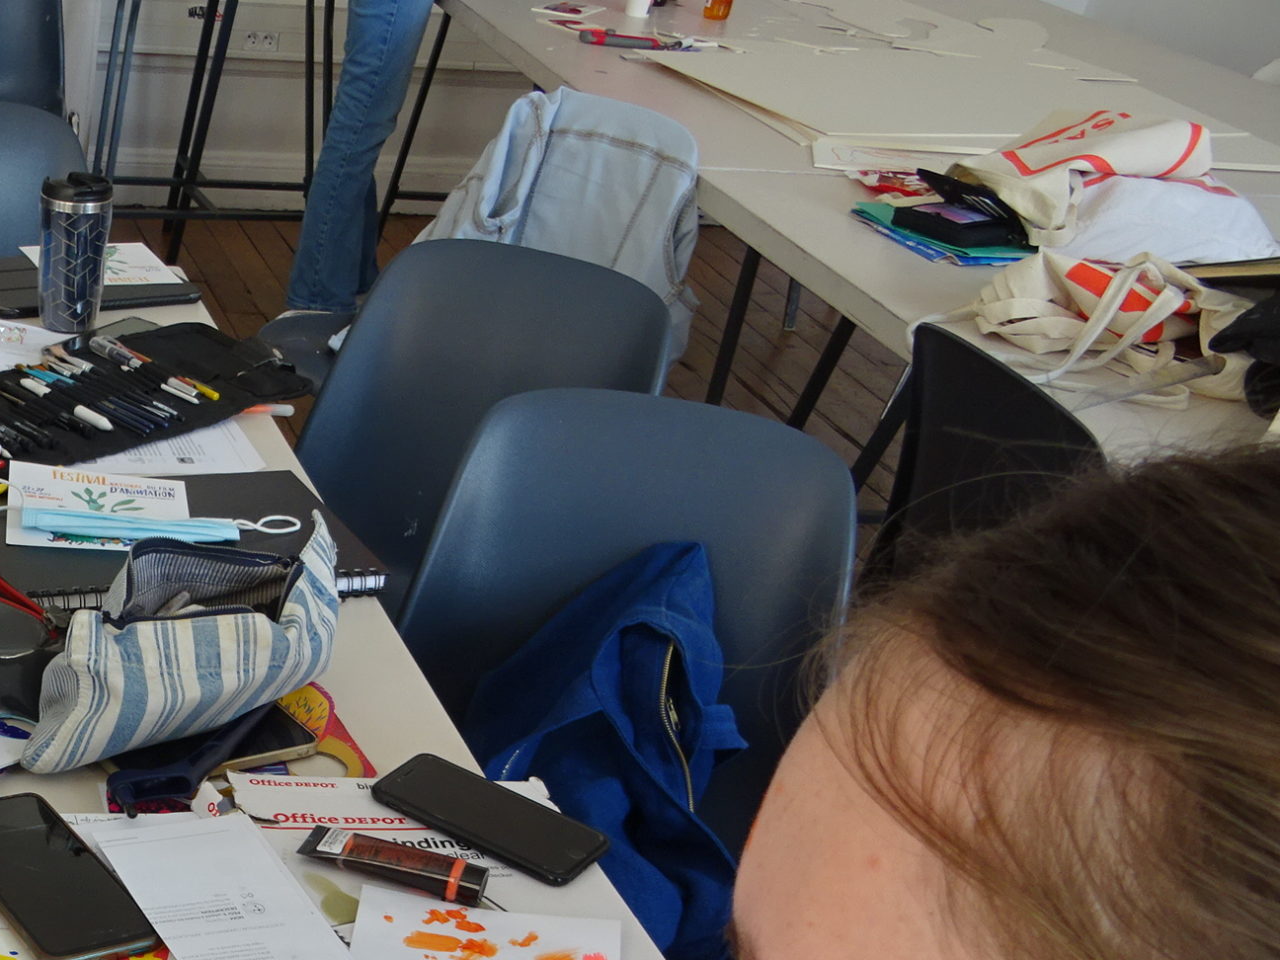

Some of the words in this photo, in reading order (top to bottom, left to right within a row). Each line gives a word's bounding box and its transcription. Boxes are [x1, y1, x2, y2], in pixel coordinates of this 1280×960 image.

[51, 470, 108, 486] FESTIVAL
[249, 778, 292, 787] Office
[273, 812, 339, 824] Office
[343, 817, 408, 825] DEPOT
